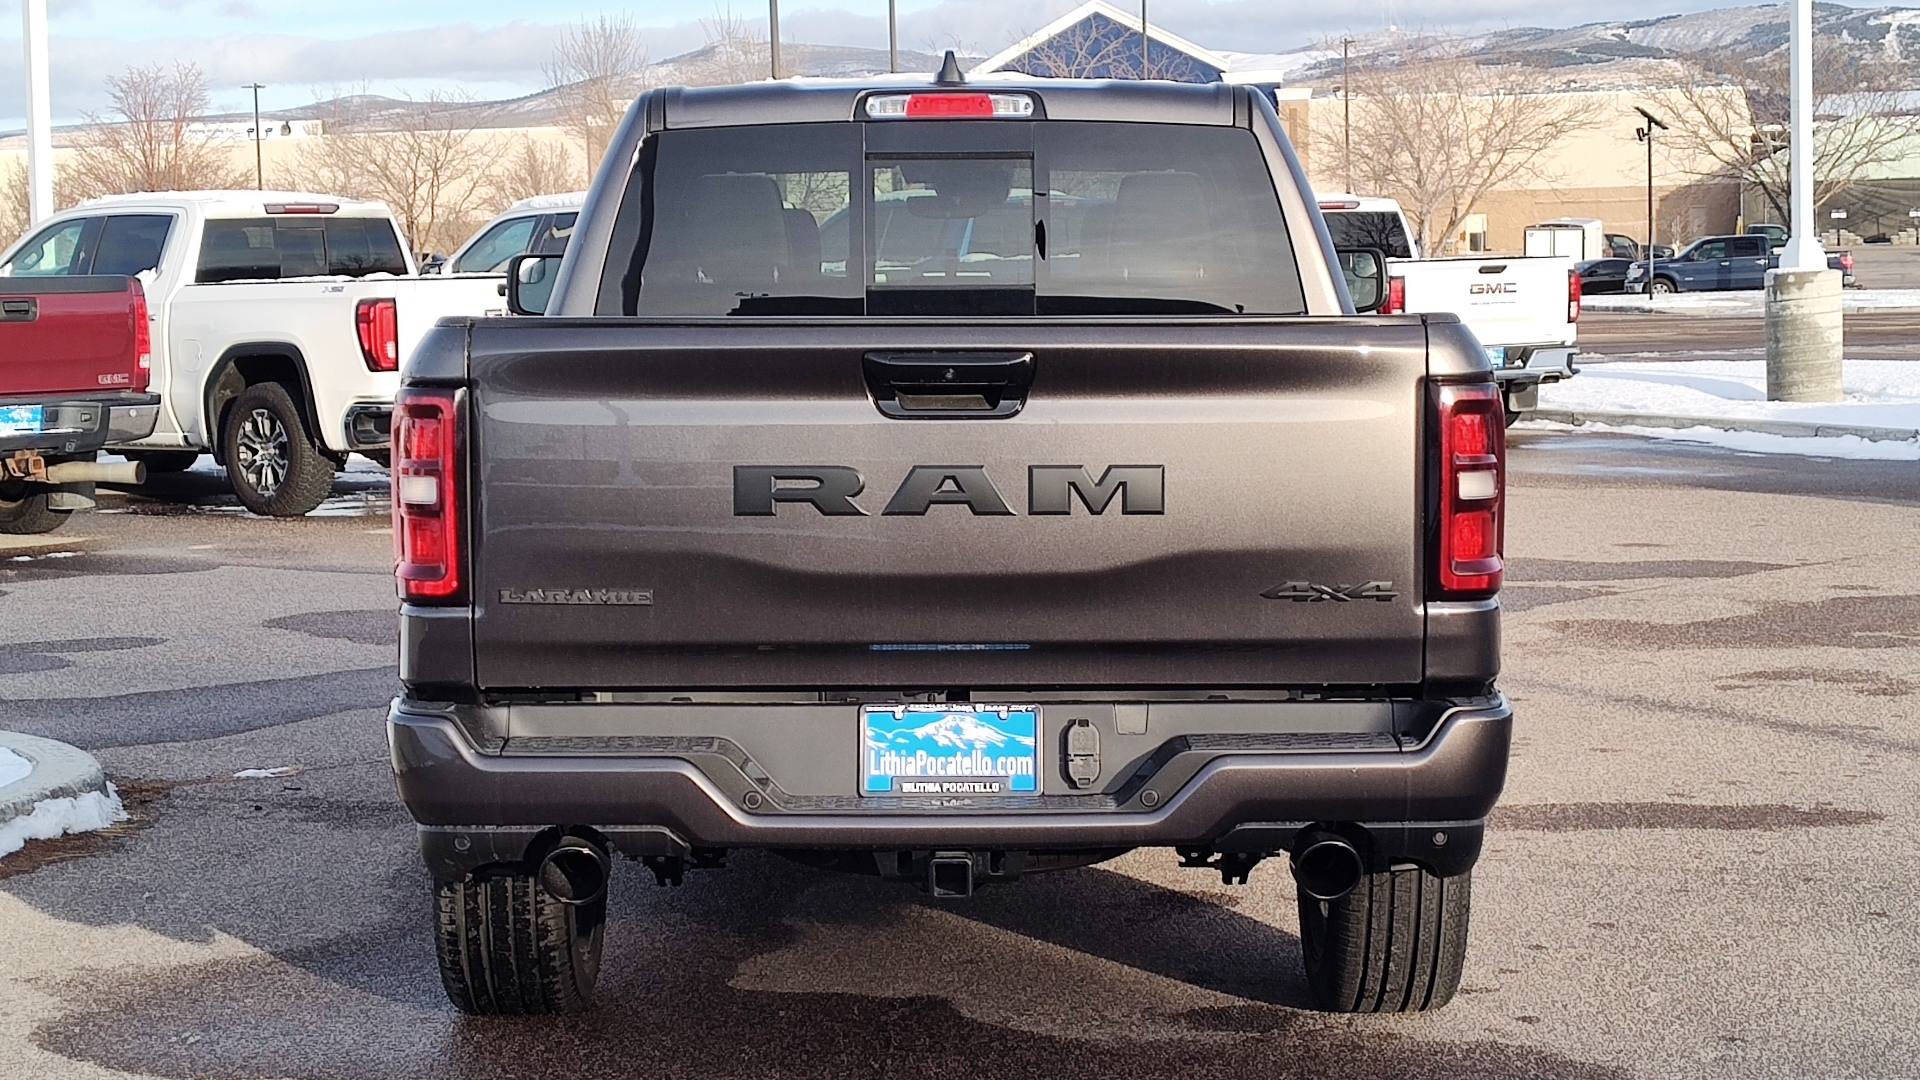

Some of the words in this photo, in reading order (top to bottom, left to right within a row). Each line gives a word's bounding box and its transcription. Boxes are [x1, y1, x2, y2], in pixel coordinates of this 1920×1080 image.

[1470, 282, 1517, 294] GMC
[733, 465, 1165, 516] RAM
[499, 588, 653, 604] LARAMIE
[869, 749, 1034, 776] LithiaPocatello.com
[912, 782, 941, 793] LITHIA
[942, 782, 1000, 793] POCATELLO
